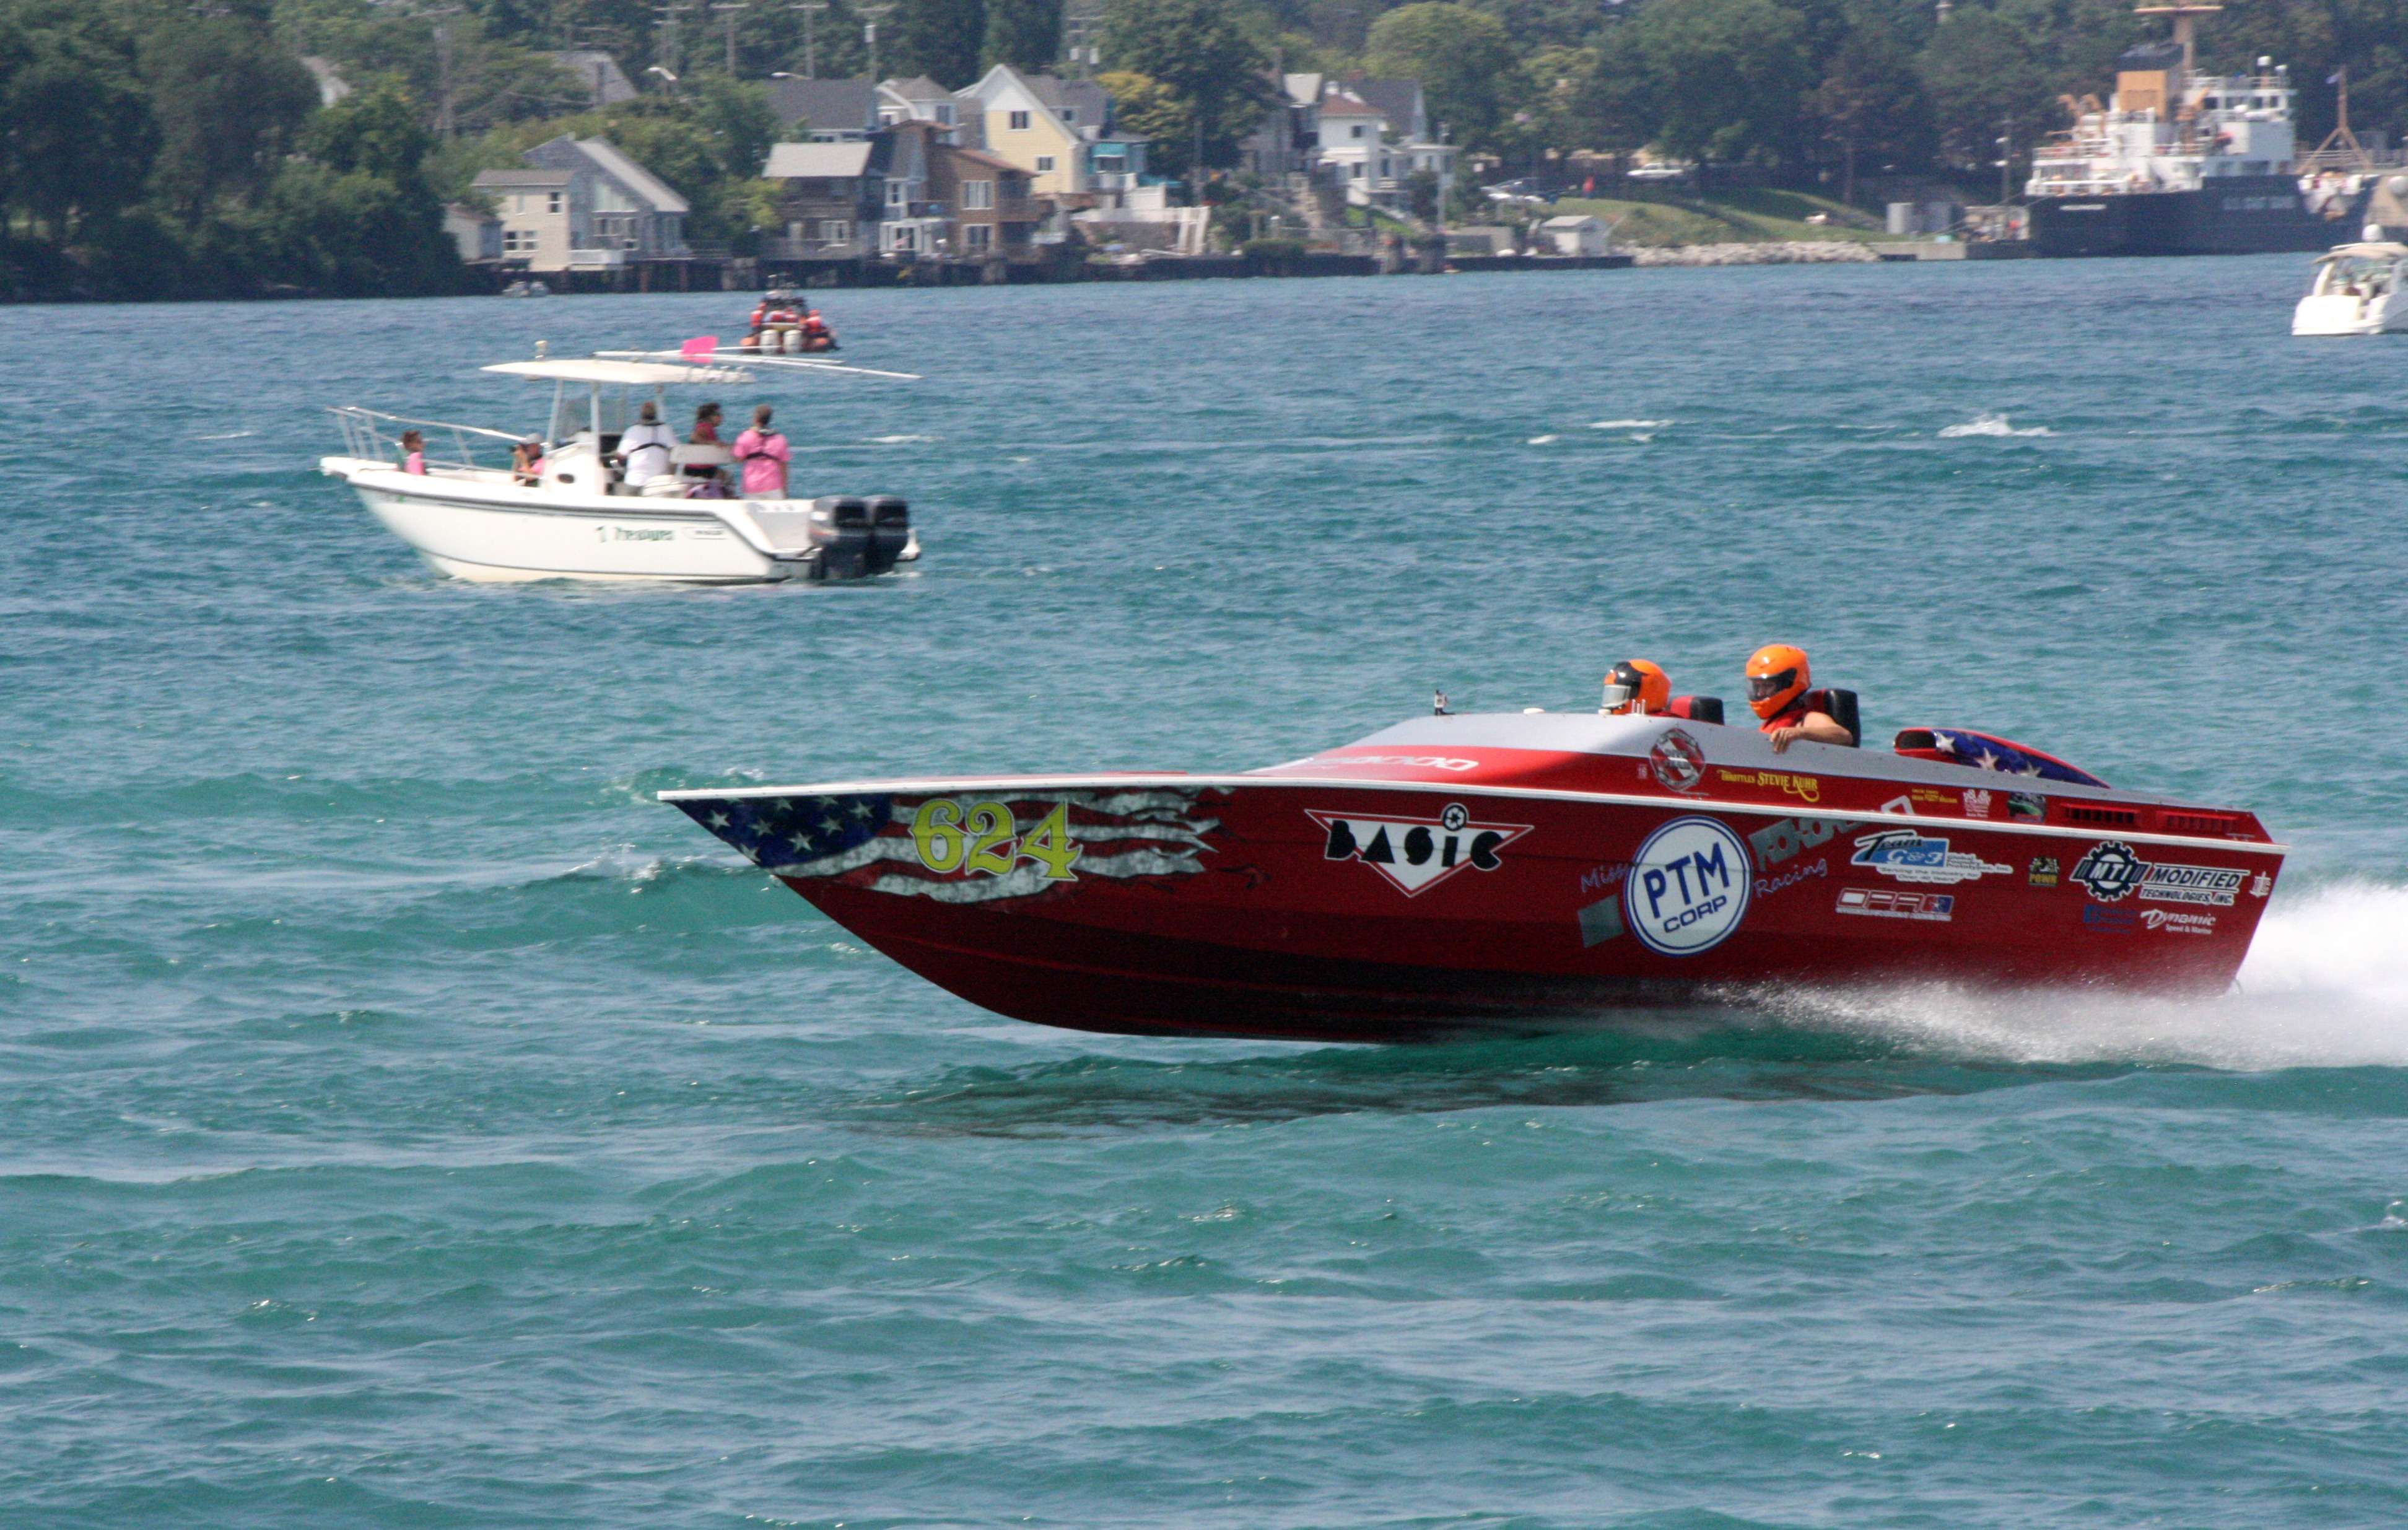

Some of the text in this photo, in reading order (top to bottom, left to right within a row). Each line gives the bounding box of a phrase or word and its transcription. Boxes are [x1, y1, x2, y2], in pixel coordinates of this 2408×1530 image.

[1757, 772, 1791, 787] STEVIE
[908, 798, 1083, 881] 624
[1857, 831, 1922, 861] Team
[1643, 841, 1730, 919] PTM
[1753, 859, 1828, 898] Racing
[2089, 862, 2133, 881] MTI
[2150, 868, 2241, 888] MODIFIED
[1663, 895, 1727, 933] CORP
[2140, 909, 2216, 929] Dynamic
